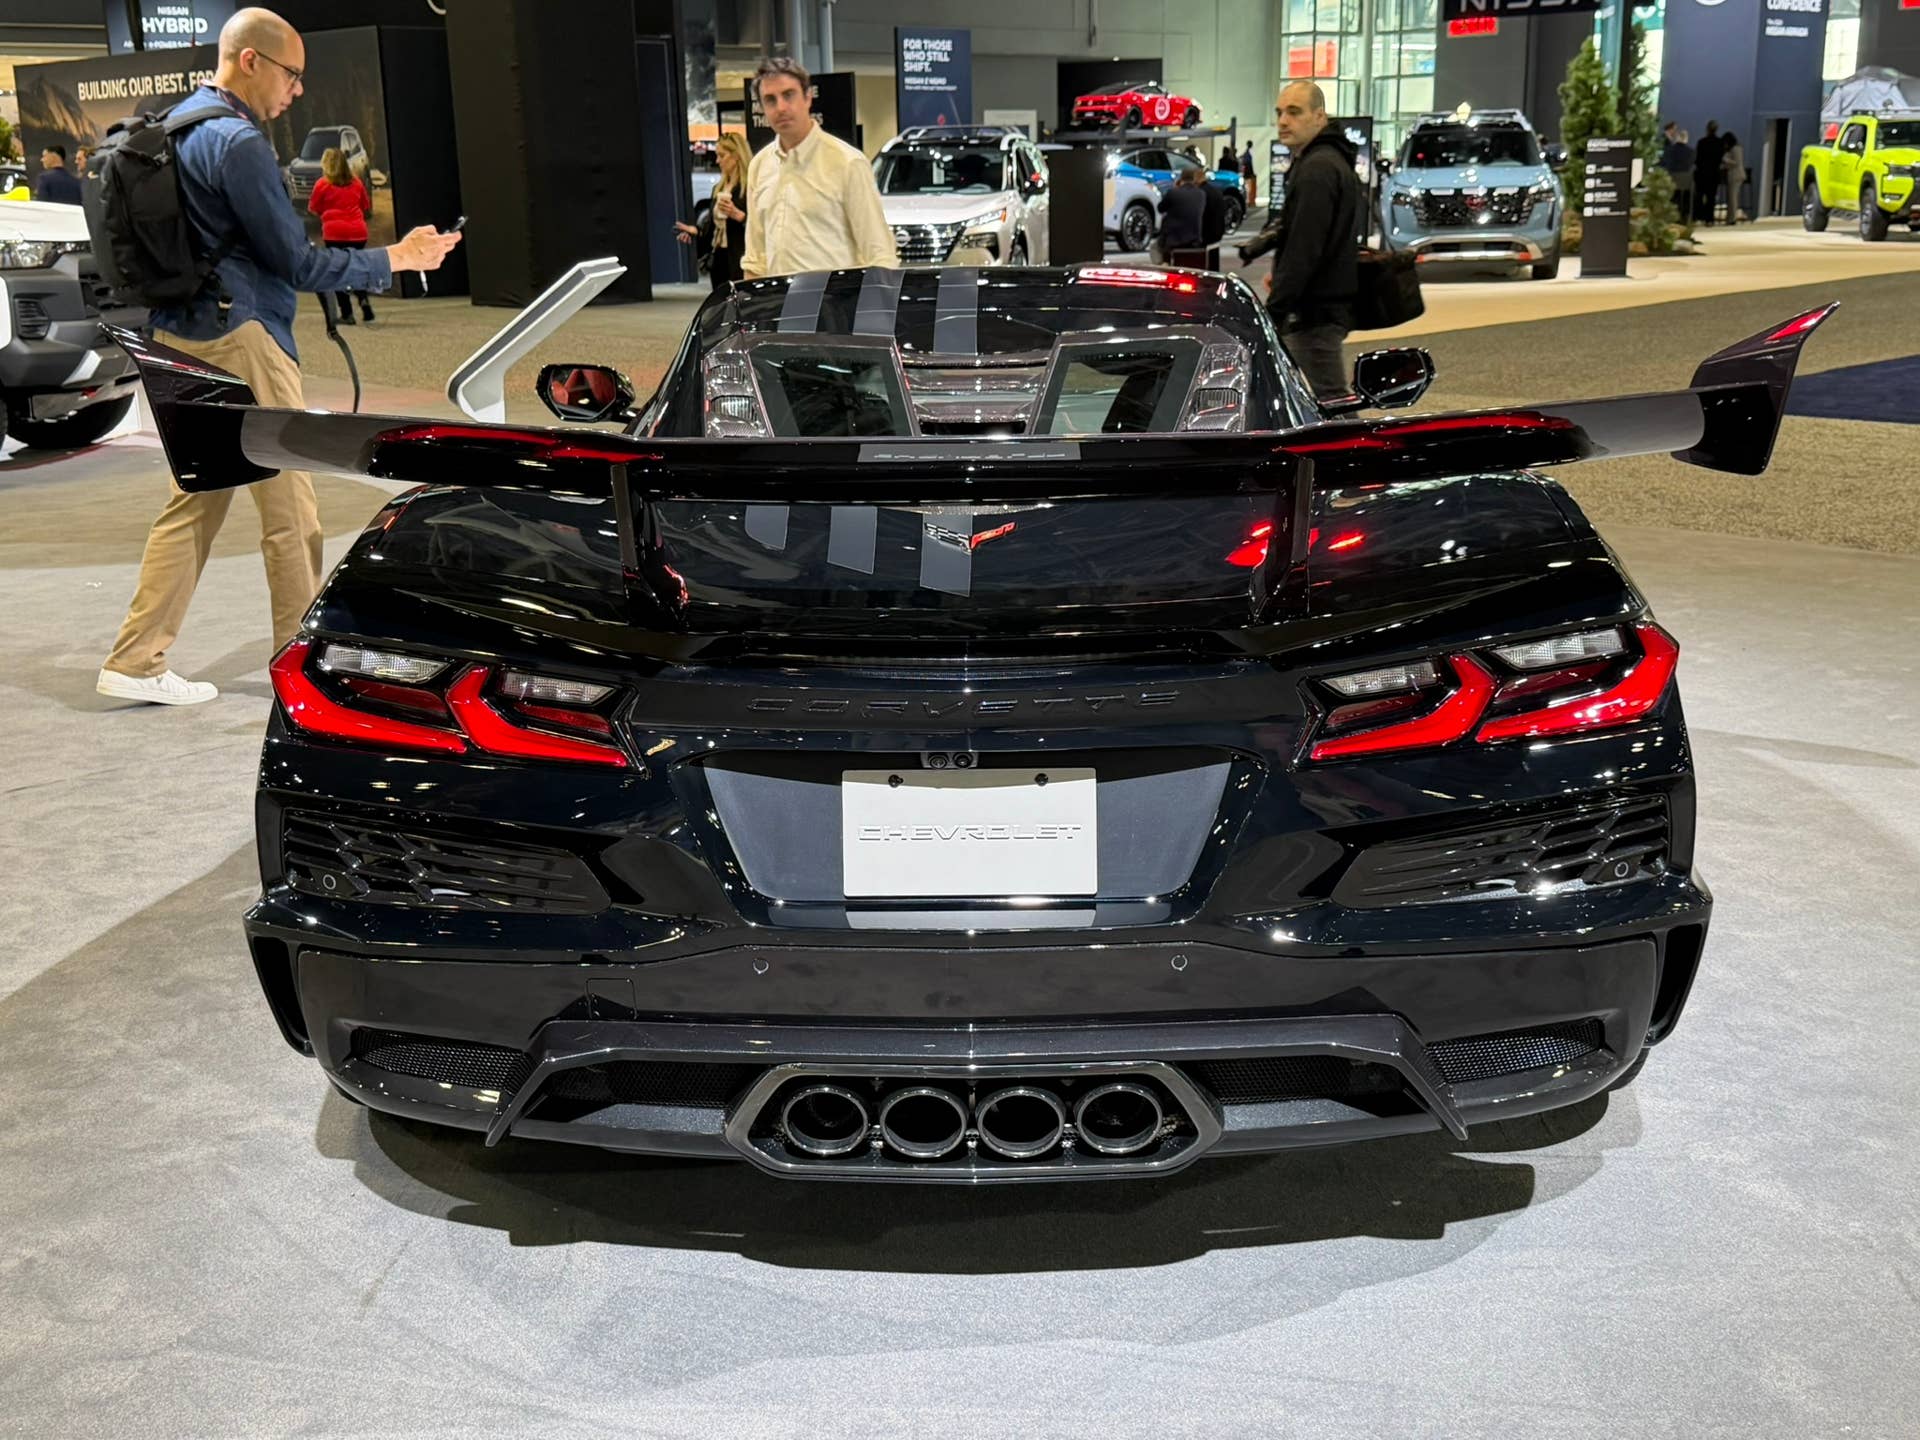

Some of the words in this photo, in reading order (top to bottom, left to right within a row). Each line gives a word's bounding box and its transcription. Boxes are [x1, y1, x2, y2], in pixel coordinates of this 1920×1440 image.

[157, 6, 189, 16] NISSAN
[141, 17, 208, 34] HYBRID
[903, 38, 922, 50] FOR
[923, 40, 952, 51] THOSE
[903, 51, 926, 62] WHO
[927, 51, 950, 62] STILL
[904, 61, 932, 73] SHIFT.
[78, 79, 127, 100] BUILDING
[128, 75, 154, 97] OUR
[154, 72, 188, 95] BEST.
[748, 691, 1180, 717] CORVETTE
[858, 824, 1082, 841] CHEVROLET
